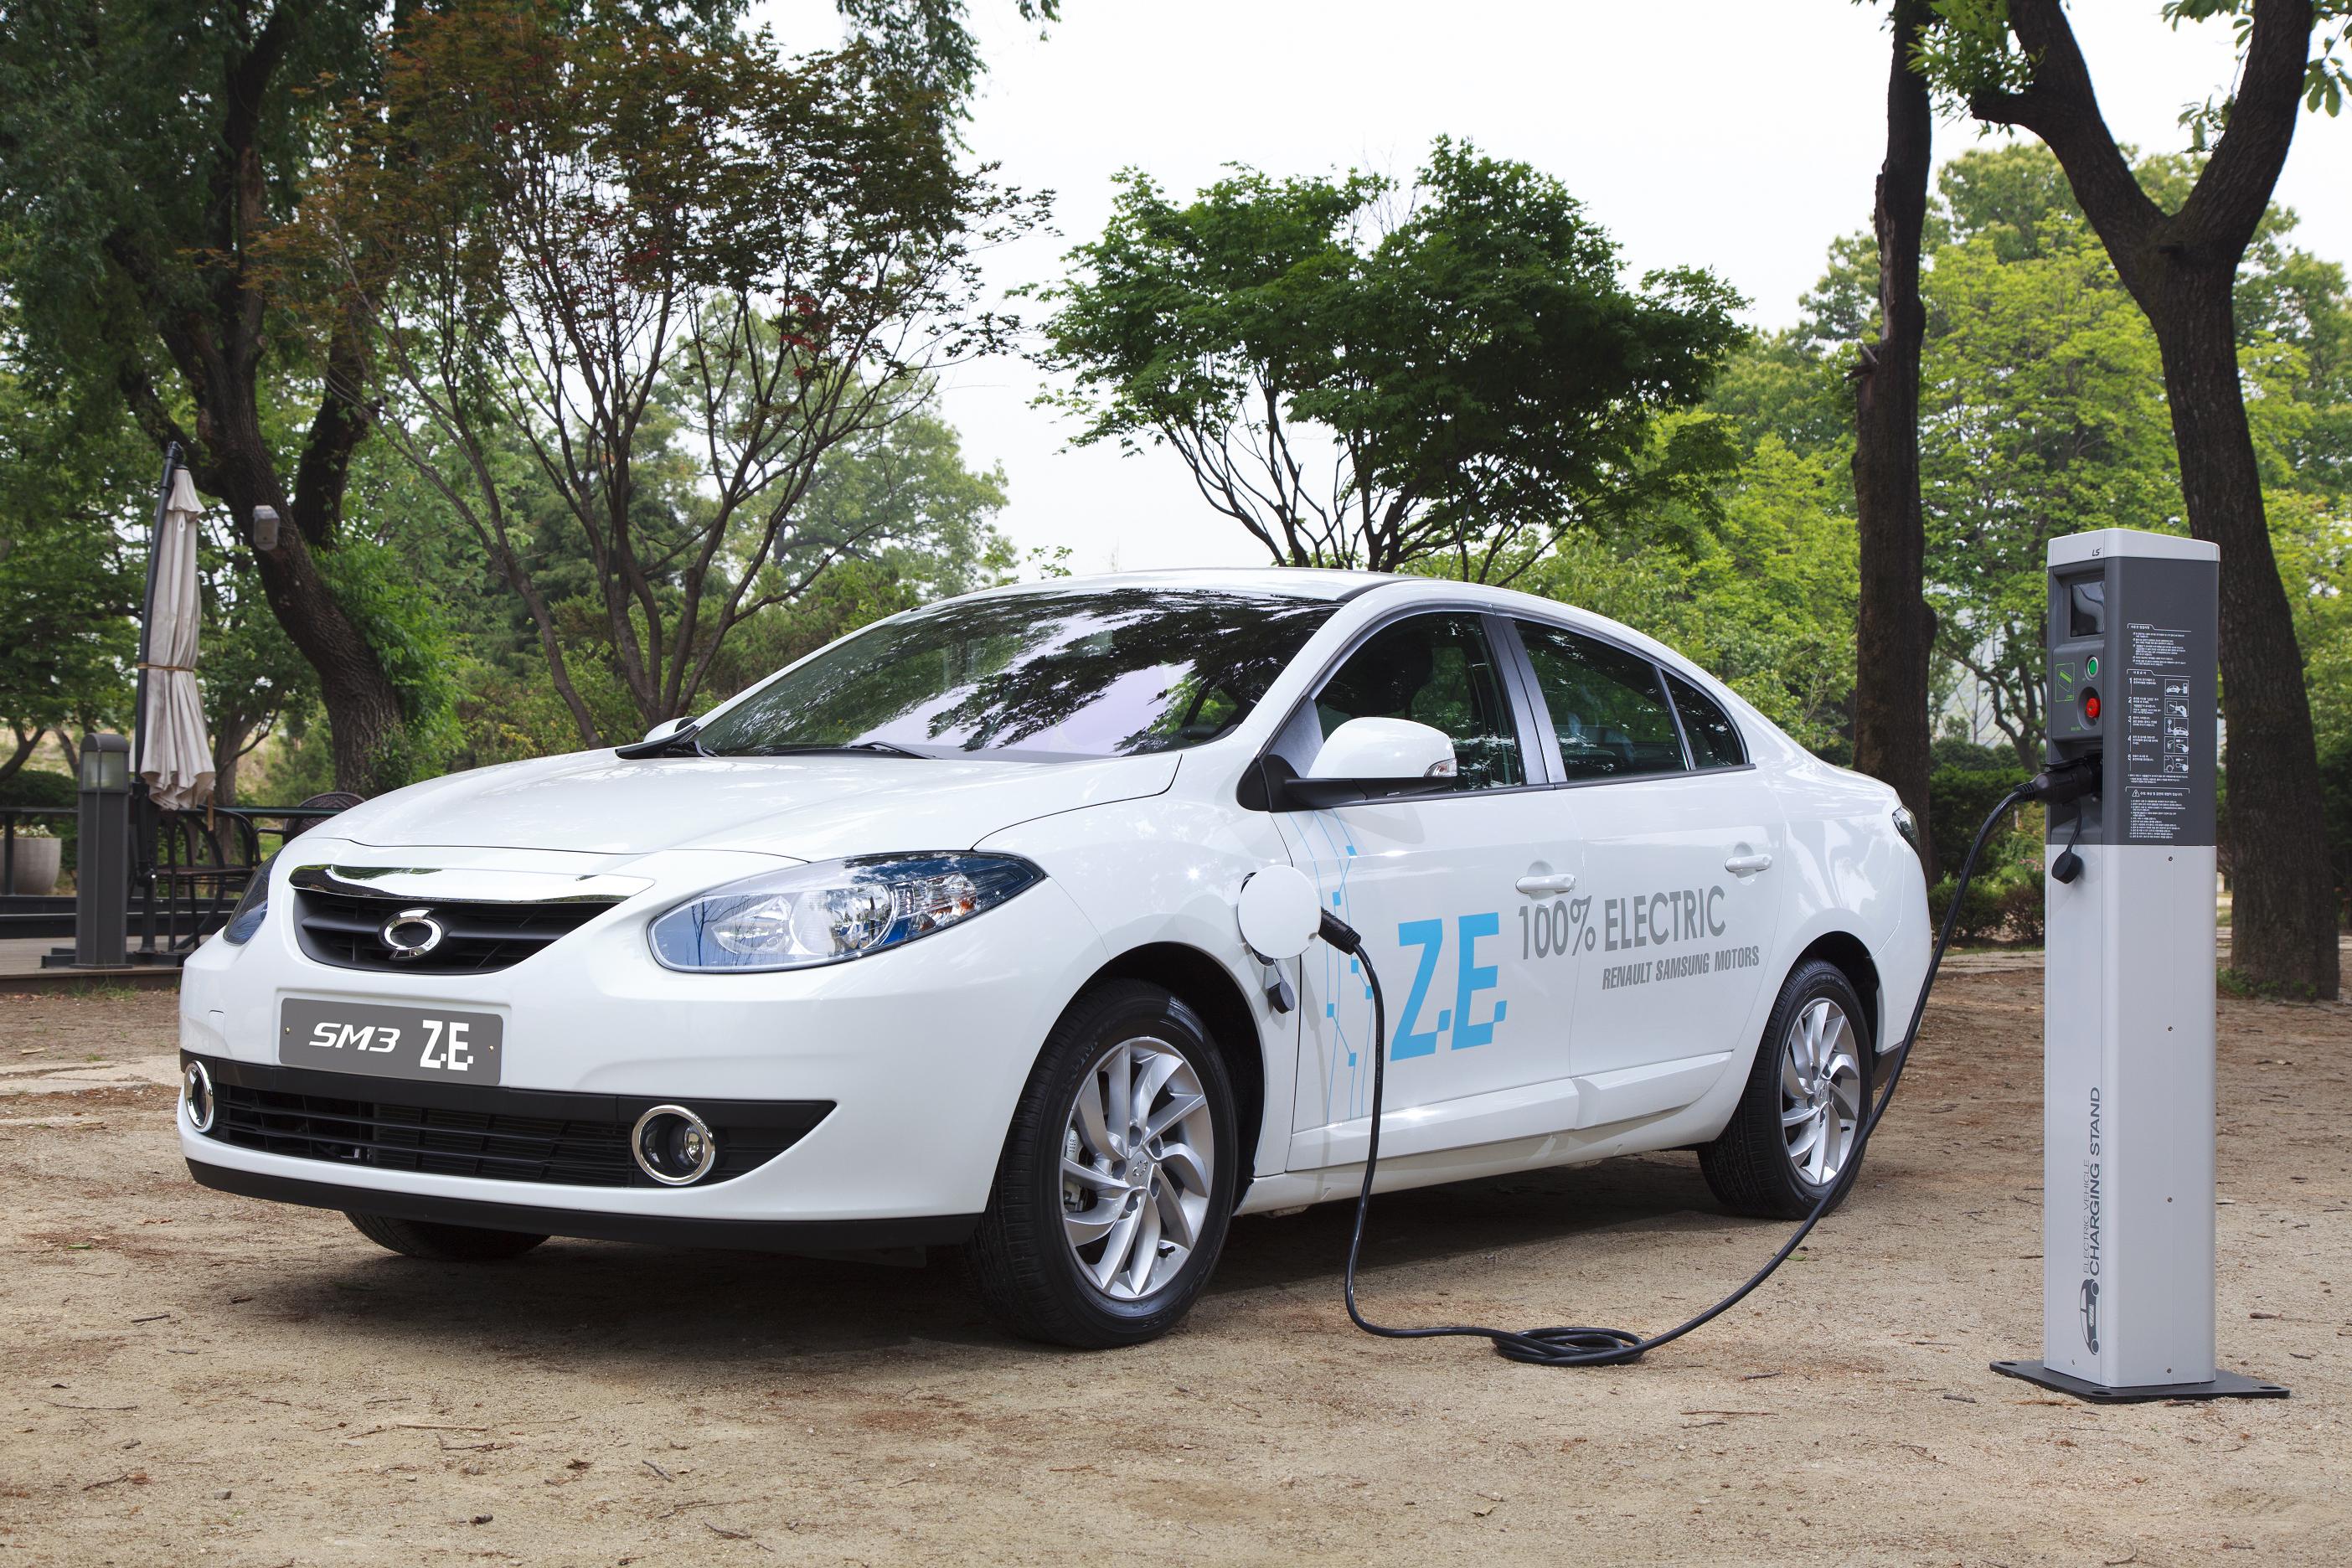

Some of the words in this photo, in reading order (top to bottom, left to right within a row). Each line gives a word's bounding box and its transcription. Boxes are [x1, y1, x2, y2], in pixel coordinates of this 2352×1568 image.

[1519, 895, 1596, 960] 100%
[1604, 885, 1726, 952] ELECTRIC
[1602, 962, 1653, 990] RENAULT
[1655, 952, 1710, 980] SAMSUNG
[1714, 946, 1760, 972] MOTORS
[309, 1022, 400, 1053] SM3
[2090, 1086, 2100, 1157] STAND
[2089, 1163, 2100, 1277] CHARGING
